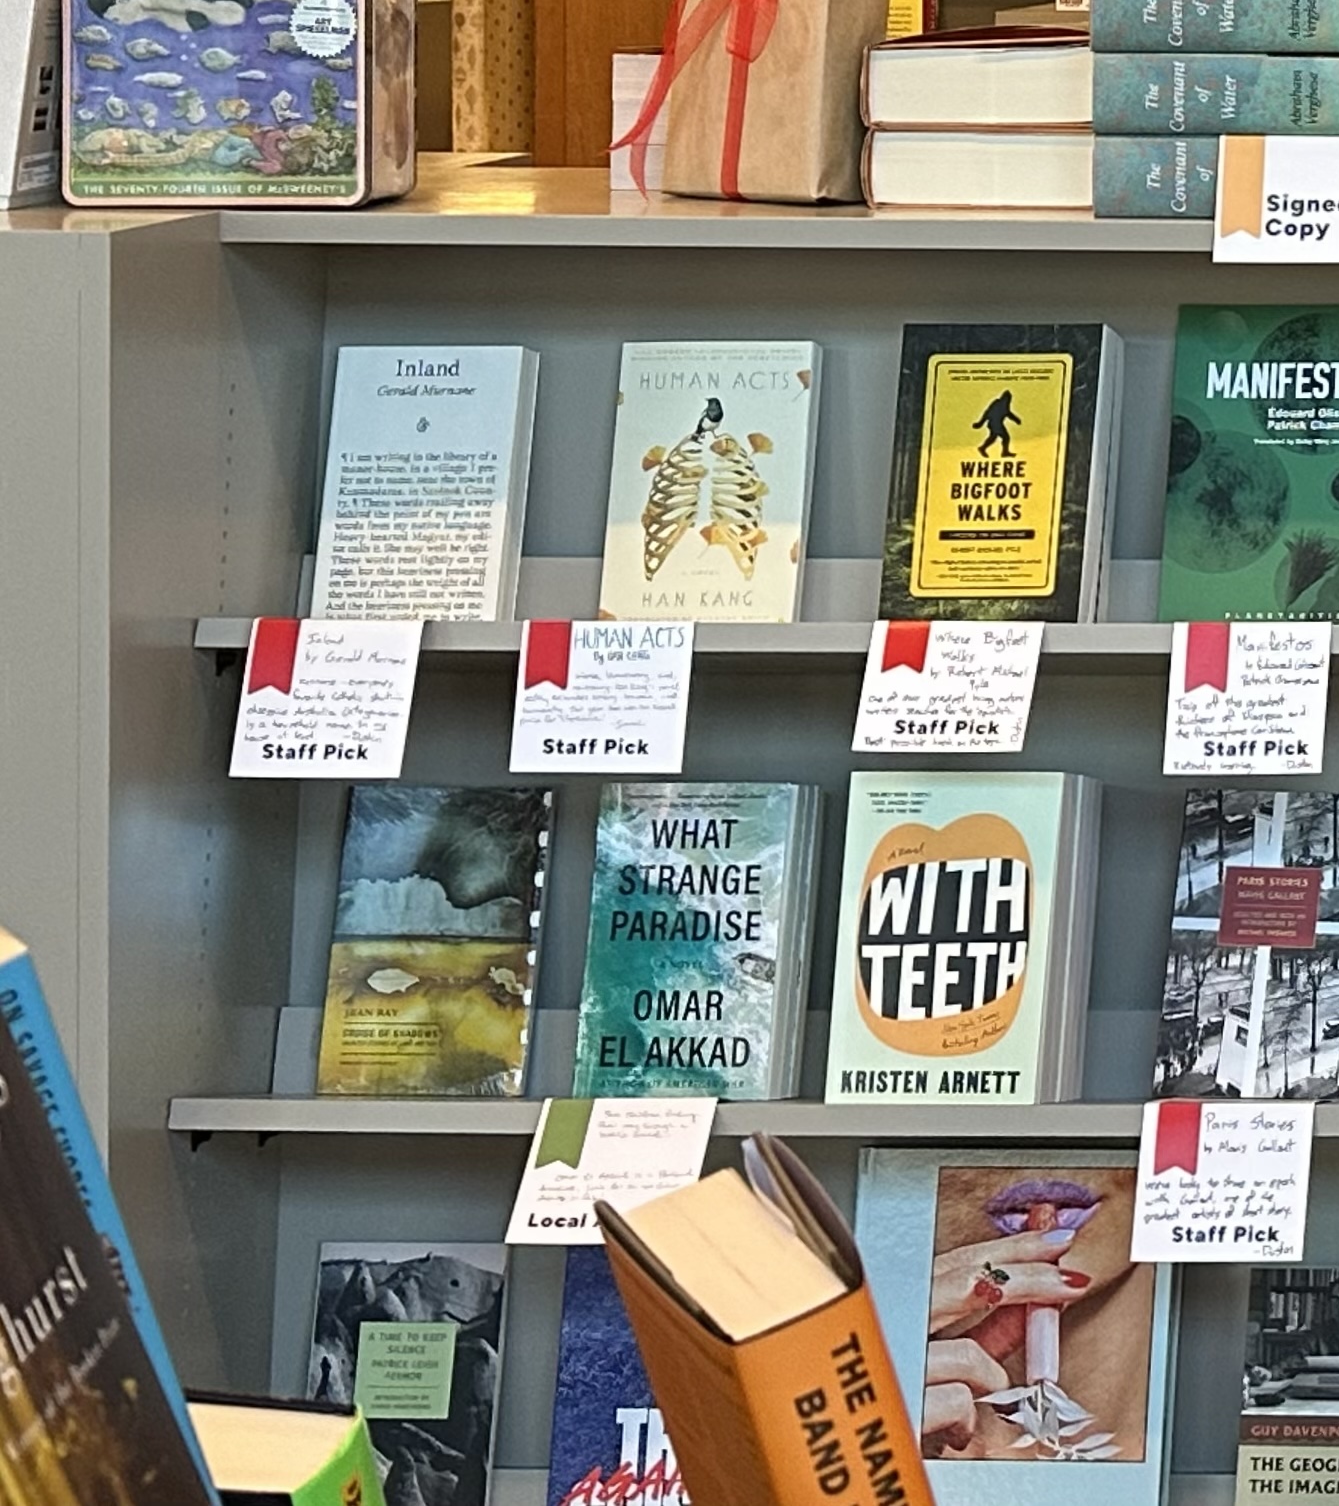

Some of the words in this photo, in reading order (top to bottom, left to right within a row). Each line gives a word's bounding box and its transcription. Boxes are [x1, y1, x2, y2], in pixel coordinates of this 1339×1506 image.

[83, 184, 104, 194] THE
[212, 184, 242, 194] ISSUE
[248, 184, 263, 194] OF
[1266, 218, 1329, 240] Copy
[396, 359, 460, 378] Inland
[640, 370, 722, 391] HUMAN
[733, 370, 790, 390] ACTS
[960, 461, 1026, 478] WHERE
[951, 482, 1032, 500] BIGFOOT
[958, 504, 1021, 521] WALKS
[642, 591, 685, 608] HAN
[701, 590, 754, 607] KANG
[262, 742, 316, 761] Staff
[323, 743, 368, 761] Pick
[652, 819, 739, 849] WHAT
[619, 865, 761, 895] STRANGE
[867, 859, 1028, 935] WITH
[610, 911, 761, 942] PARADISE
[861, 941, 1027, 1021] TEETH
[633, 991, 723, 1020] OMAR
[600, 1039, 634, 1067] EL
[644, 1037, 751, 1068] AKKAD
[841, 1071, 928, 1094] KRISTEN
[939, 1070, 1020, 1094] ARNETT
[528, 1213, 587, 1229] Local
[1251, 1424, 1278, 1438] GUY
[1250, 1457, 1285, 1472] THE
[1249, 1479, 1284, 1494] THE
